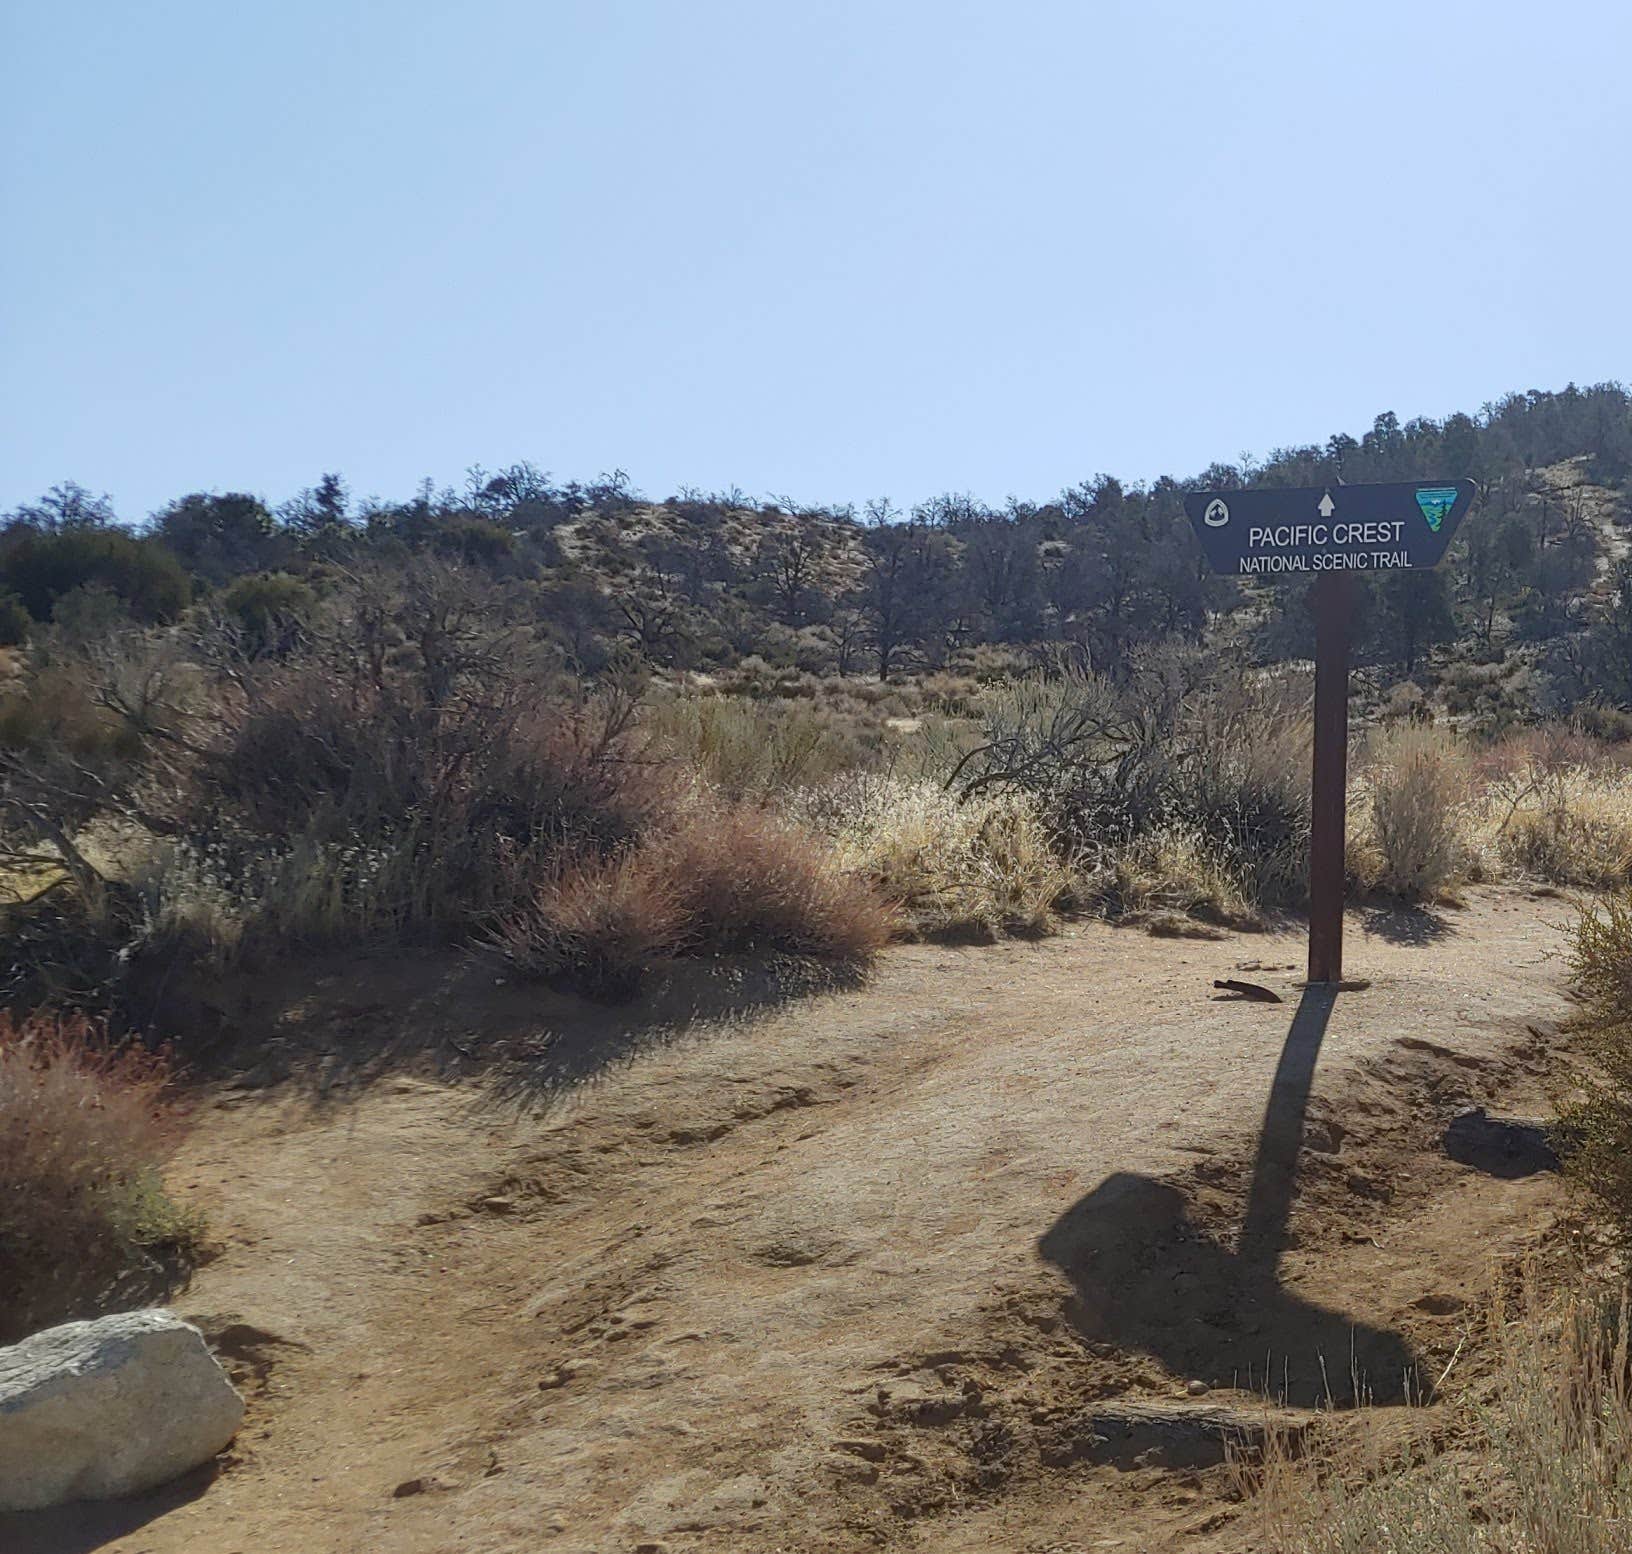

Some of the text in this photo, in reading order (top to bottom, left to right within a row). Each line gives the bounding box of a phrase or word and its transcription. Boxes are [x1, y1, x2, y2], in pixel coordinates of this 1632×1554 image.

[1249, 521, 1405, 547] PACIFIC CREST
[1239, 551, 1412, 573] NATIONAL SCENIC TRAIL
